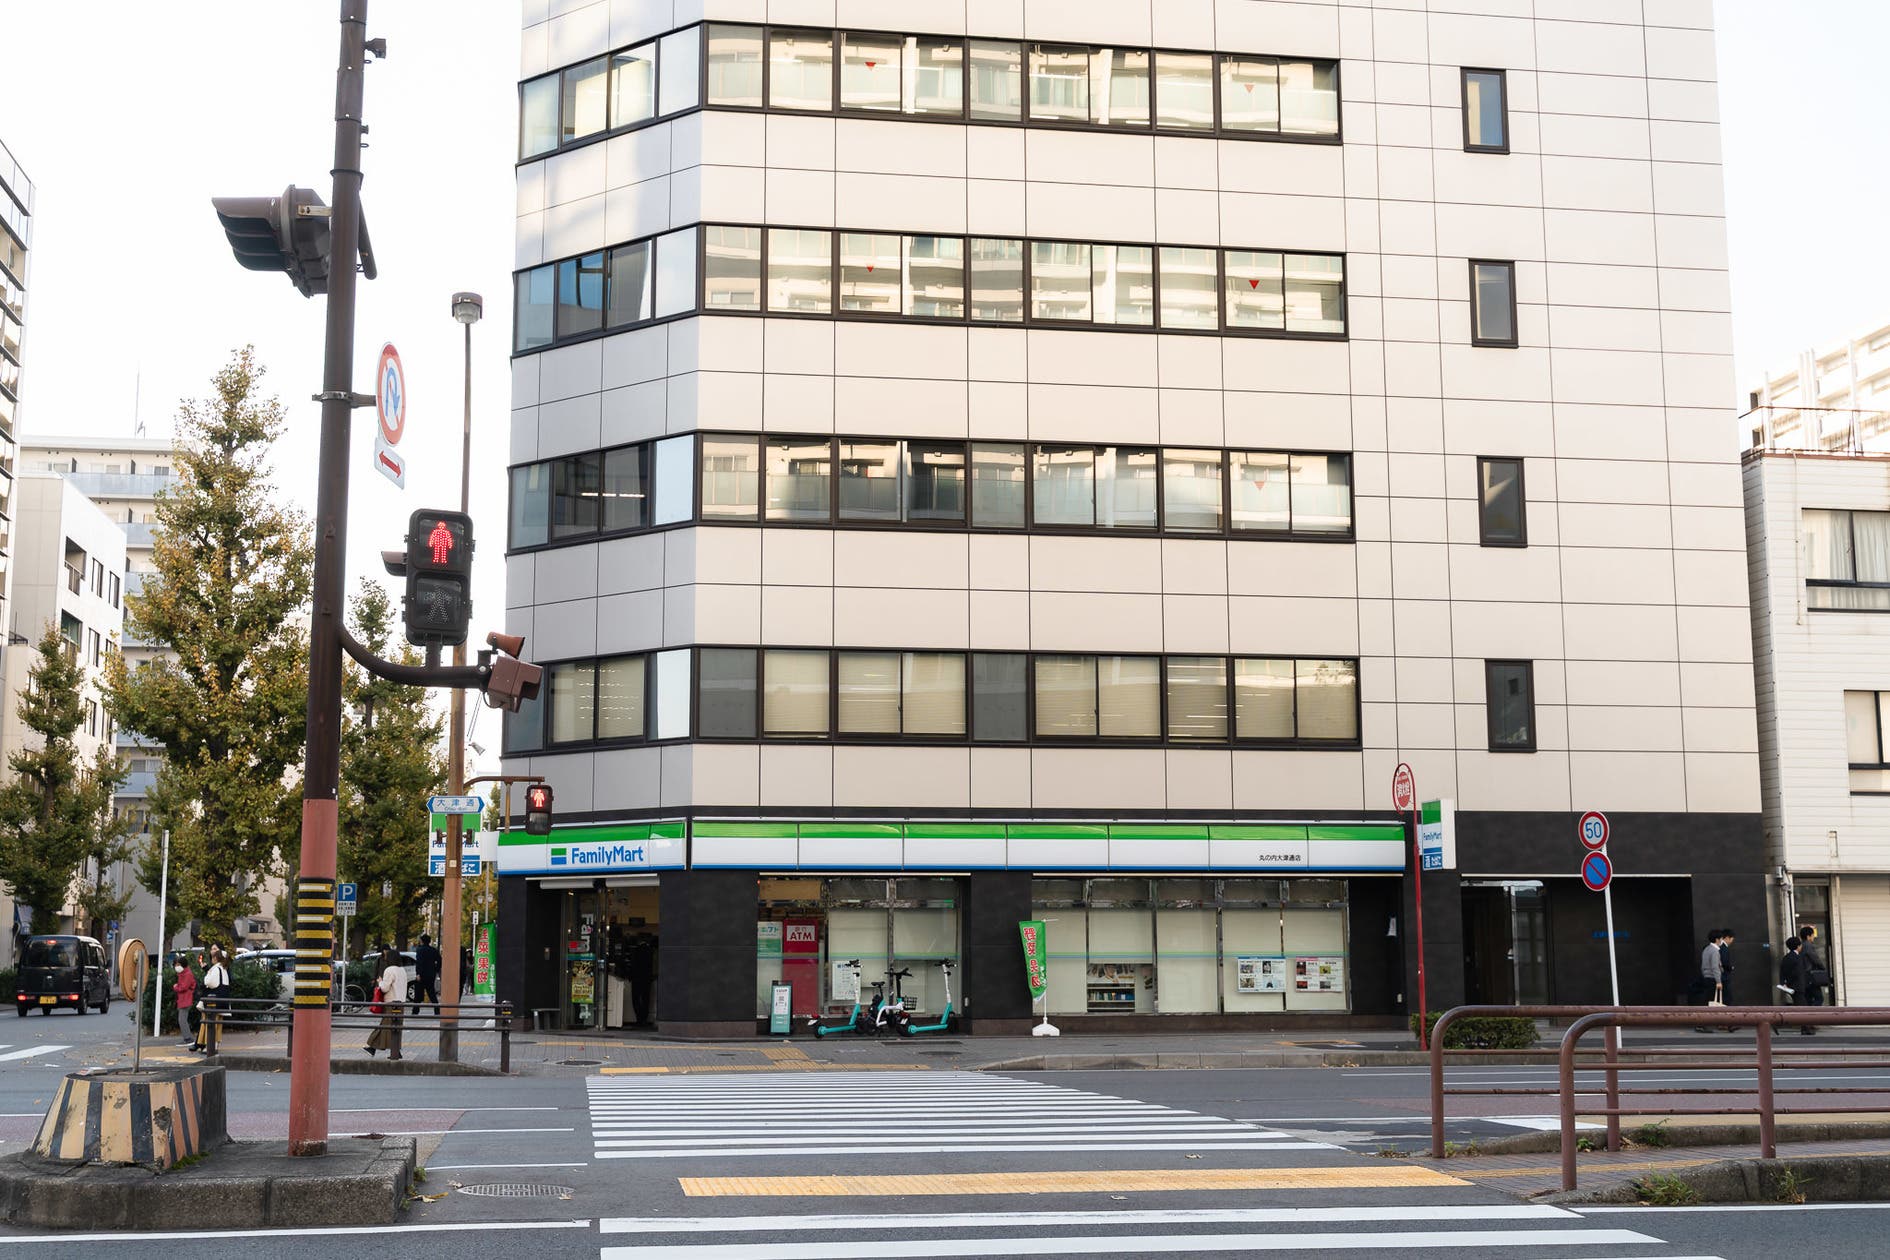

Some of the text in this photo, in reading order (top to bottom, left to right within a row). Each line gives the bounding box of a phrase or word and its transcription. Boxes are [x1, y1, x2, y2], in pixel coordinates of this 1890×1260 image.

[1584, 821, 1603, 839] 50
[571, 845, 644, 866] FamilyMart
[1259, 854, 1301, 862] 丸の内大津通店
[342, 885, 354, 900] P
[789, 931, 813, 941] ATM
